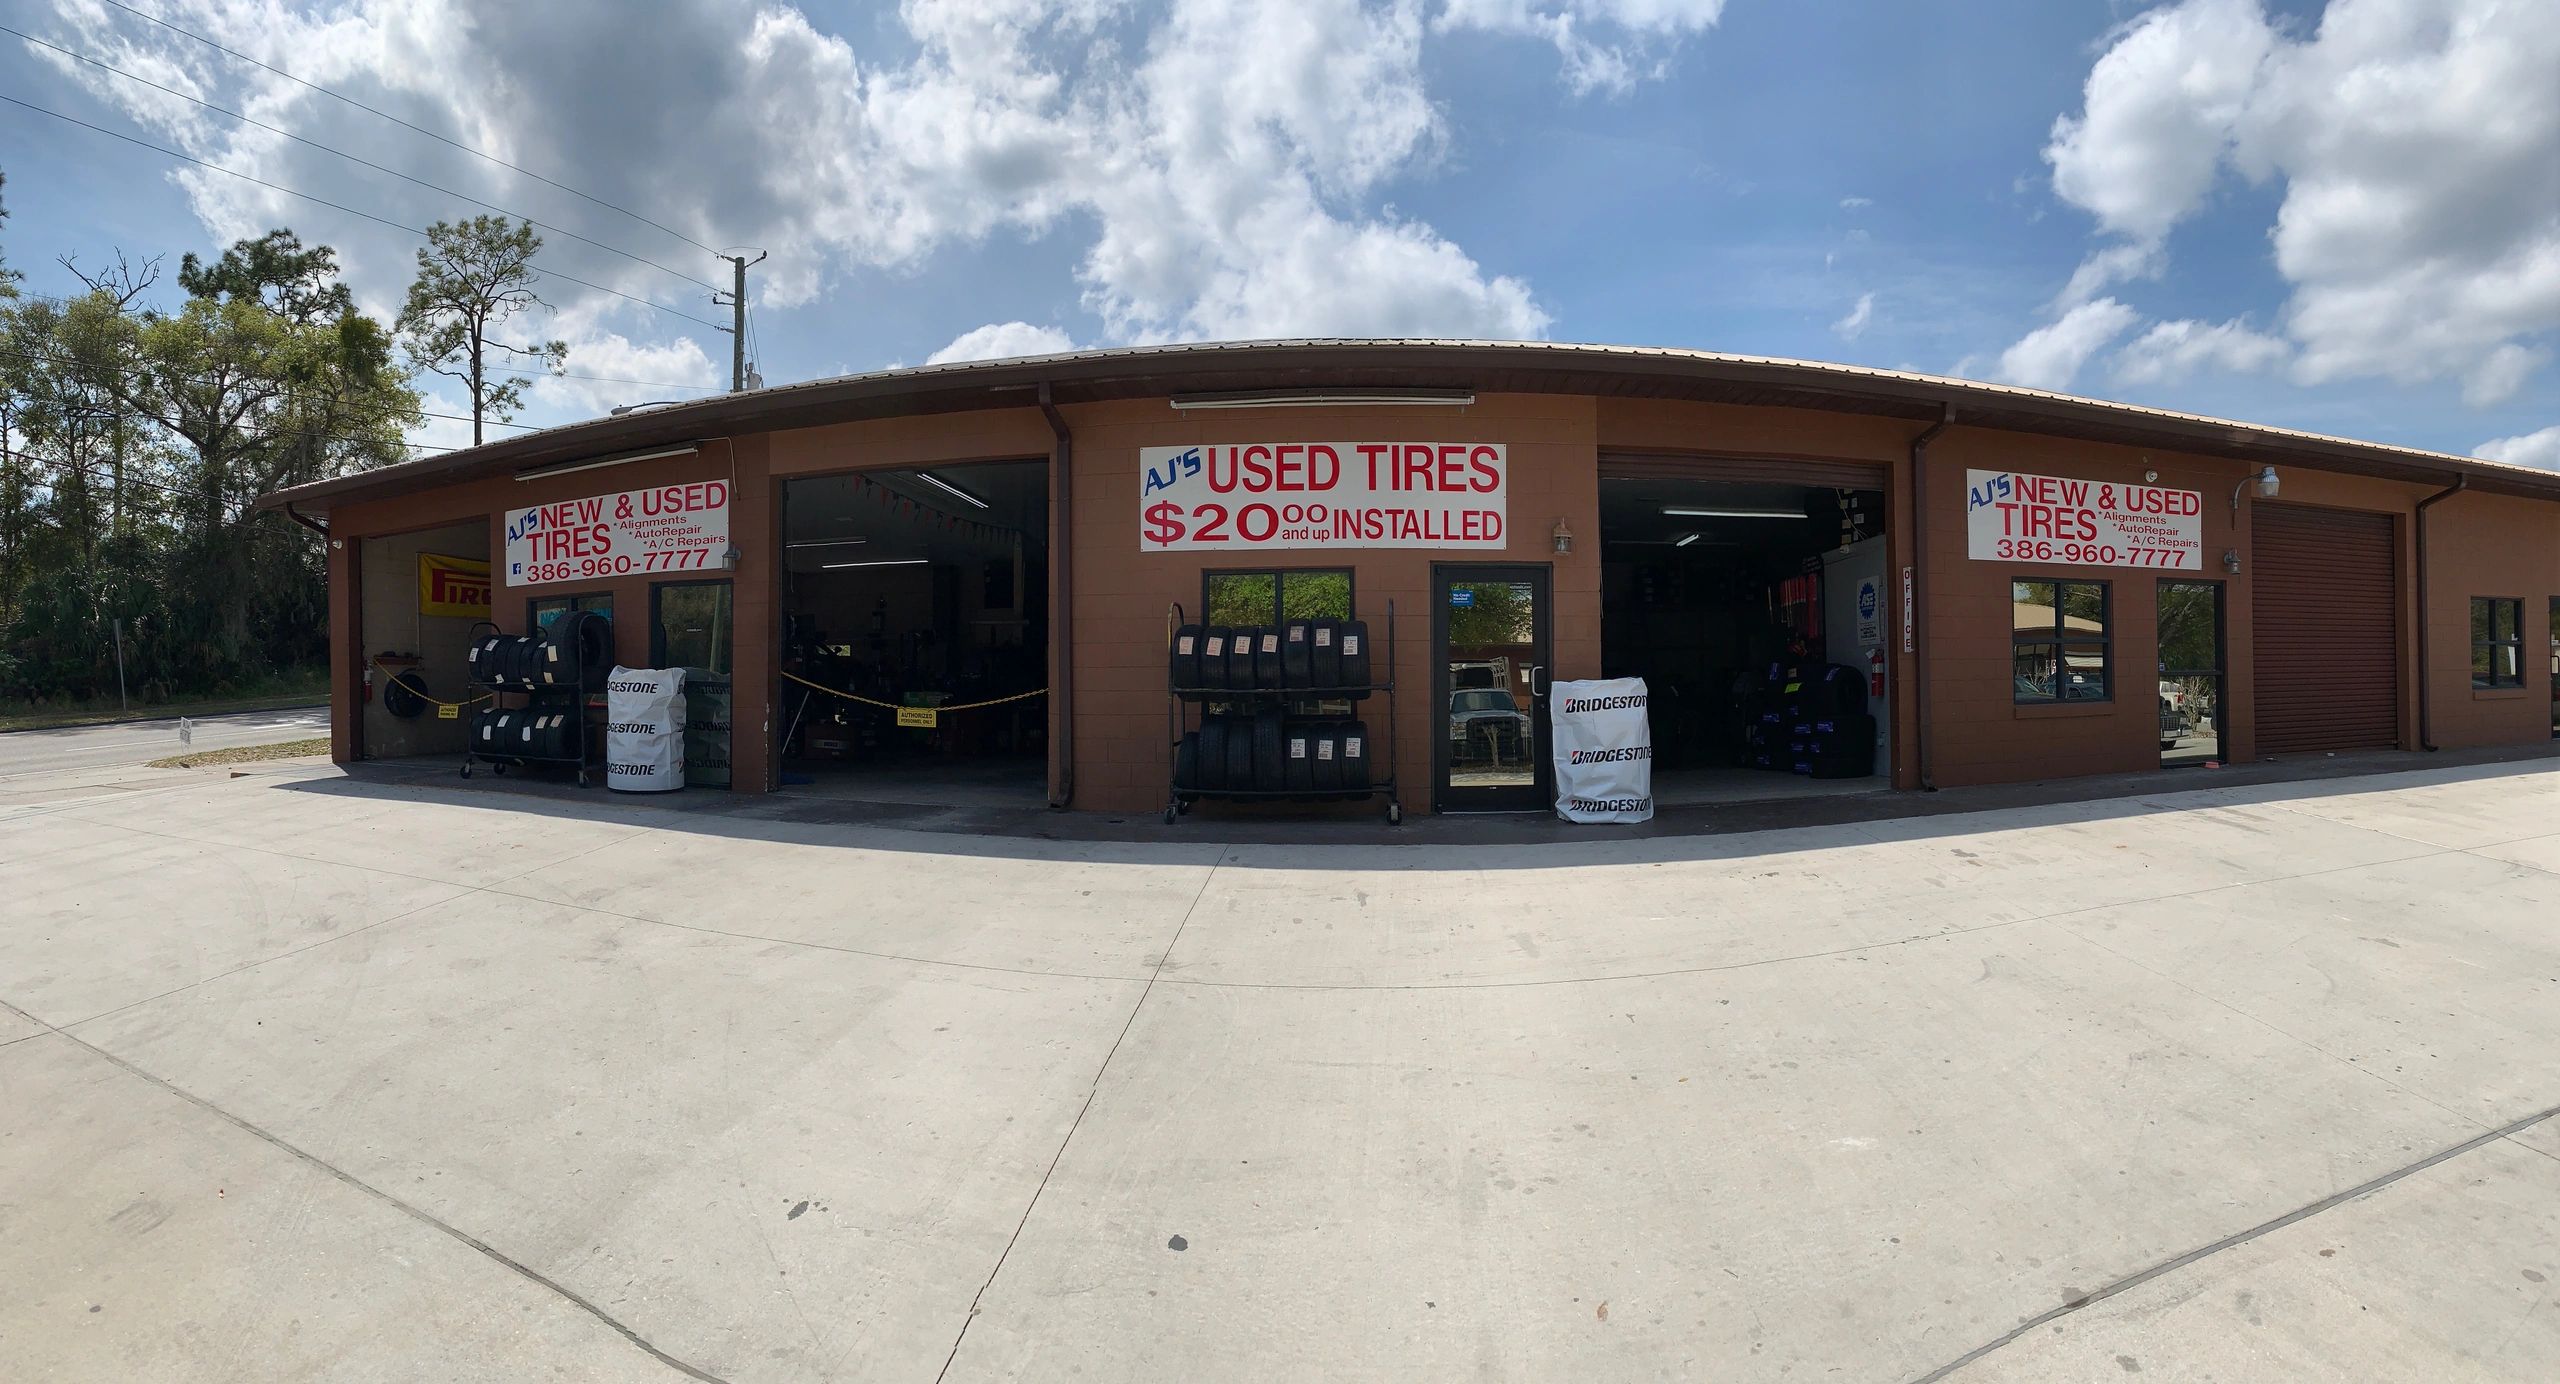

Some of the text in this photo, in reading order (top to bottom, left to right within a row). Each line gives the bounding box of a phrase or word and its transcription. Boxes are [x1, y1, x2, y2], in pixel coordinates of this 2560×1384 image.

[1145, 445, 1500, 497] AJ'S USED TIRES
[1969, 473, 2200, 516] AJ'S NEW & USED
[508, 482, 727, 546] AJ'S NEW & USED
[1334, 508, 1502, 541] INSTALLED
[1995, 502, 2097, 542] TIRES
[526, 524, 611, 562] TIRES
[678, 535, 726, 548] Repairs
[1282, 526, 1330, 543] and up
[2158, 538, 2199, 549] Repairs
[528, 548, 710, 582] 386-960-7777
[1997, 539, 2186, 568] 386-960-7777
